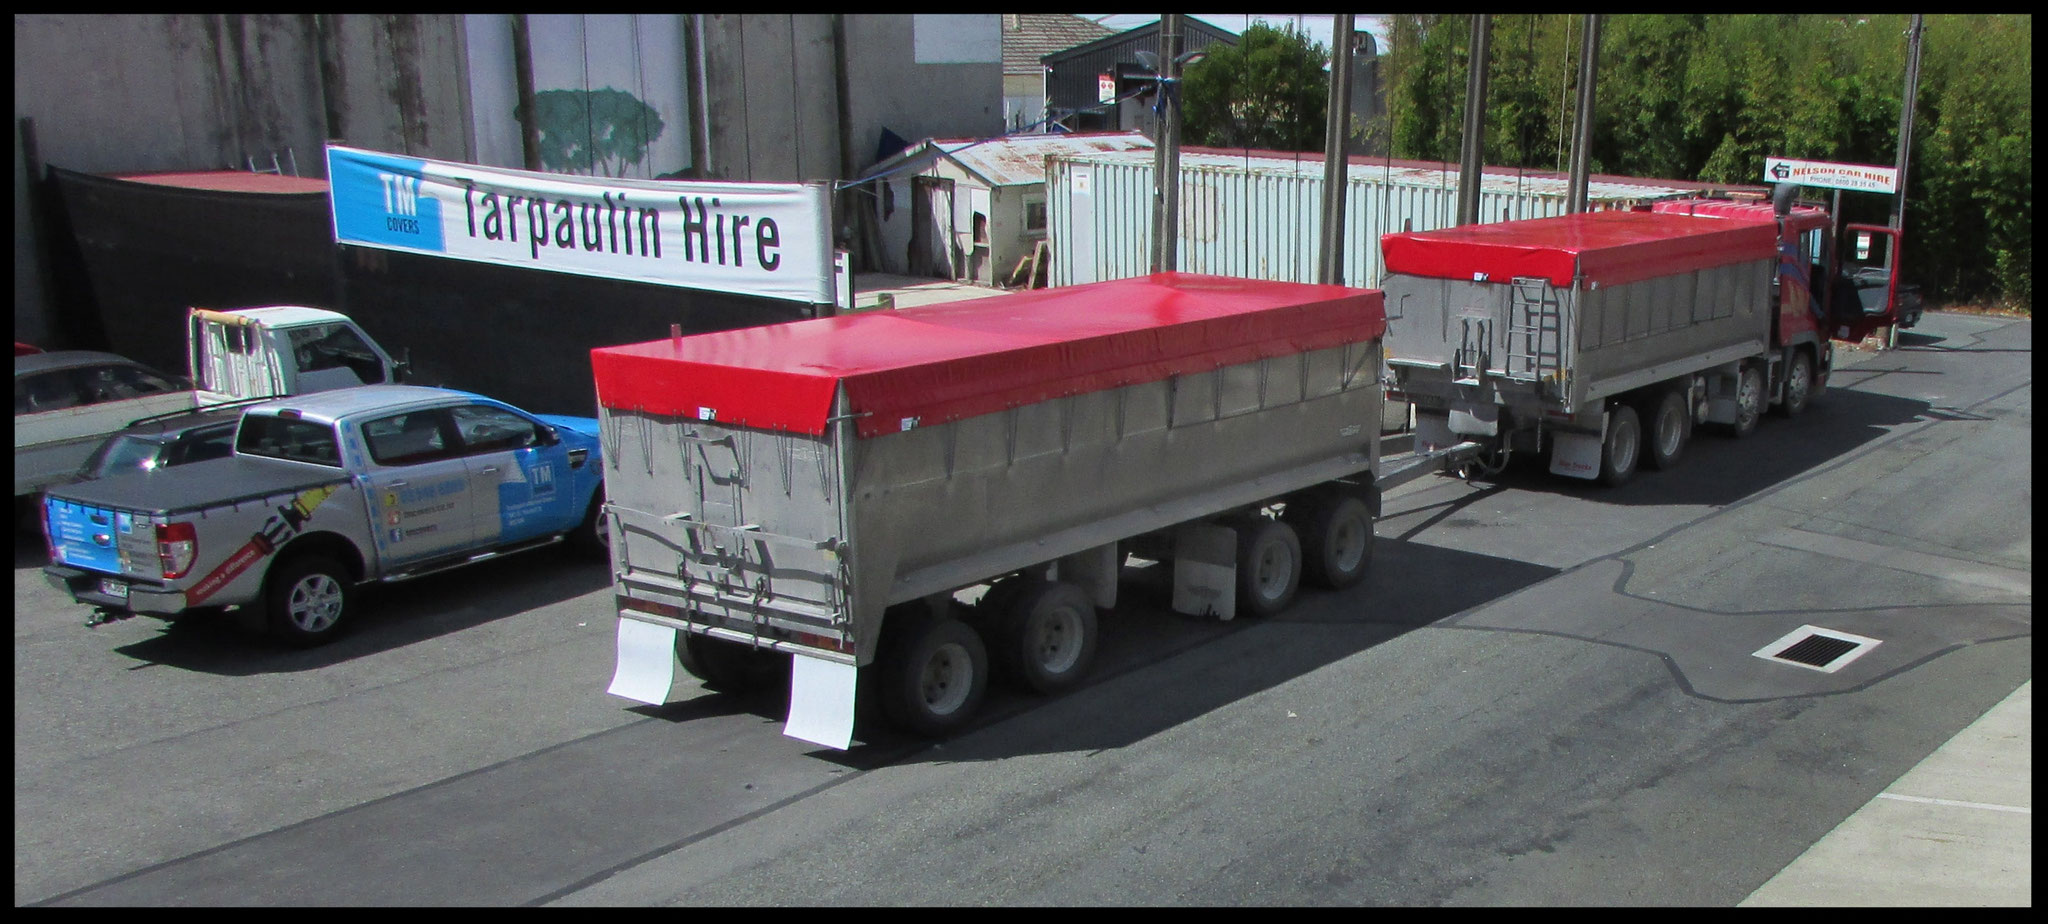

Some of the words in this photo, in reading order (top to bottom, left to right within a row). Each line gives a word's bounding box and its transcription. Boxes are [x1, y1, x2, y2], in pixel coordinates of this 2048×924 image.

[1793, 167, 1836, 177] NELSON
[1838, 168, 1862, 178] CAR
[1864, 171, 1891, 186] HIRE
[380, 173, 417, 216] TM
[386, 217, 420, 235] COVERS
[454, 177, 662, 260] Tarpaulin
[678, 195, 782, 272] Hire
[531, 465, 552, 485] TM
